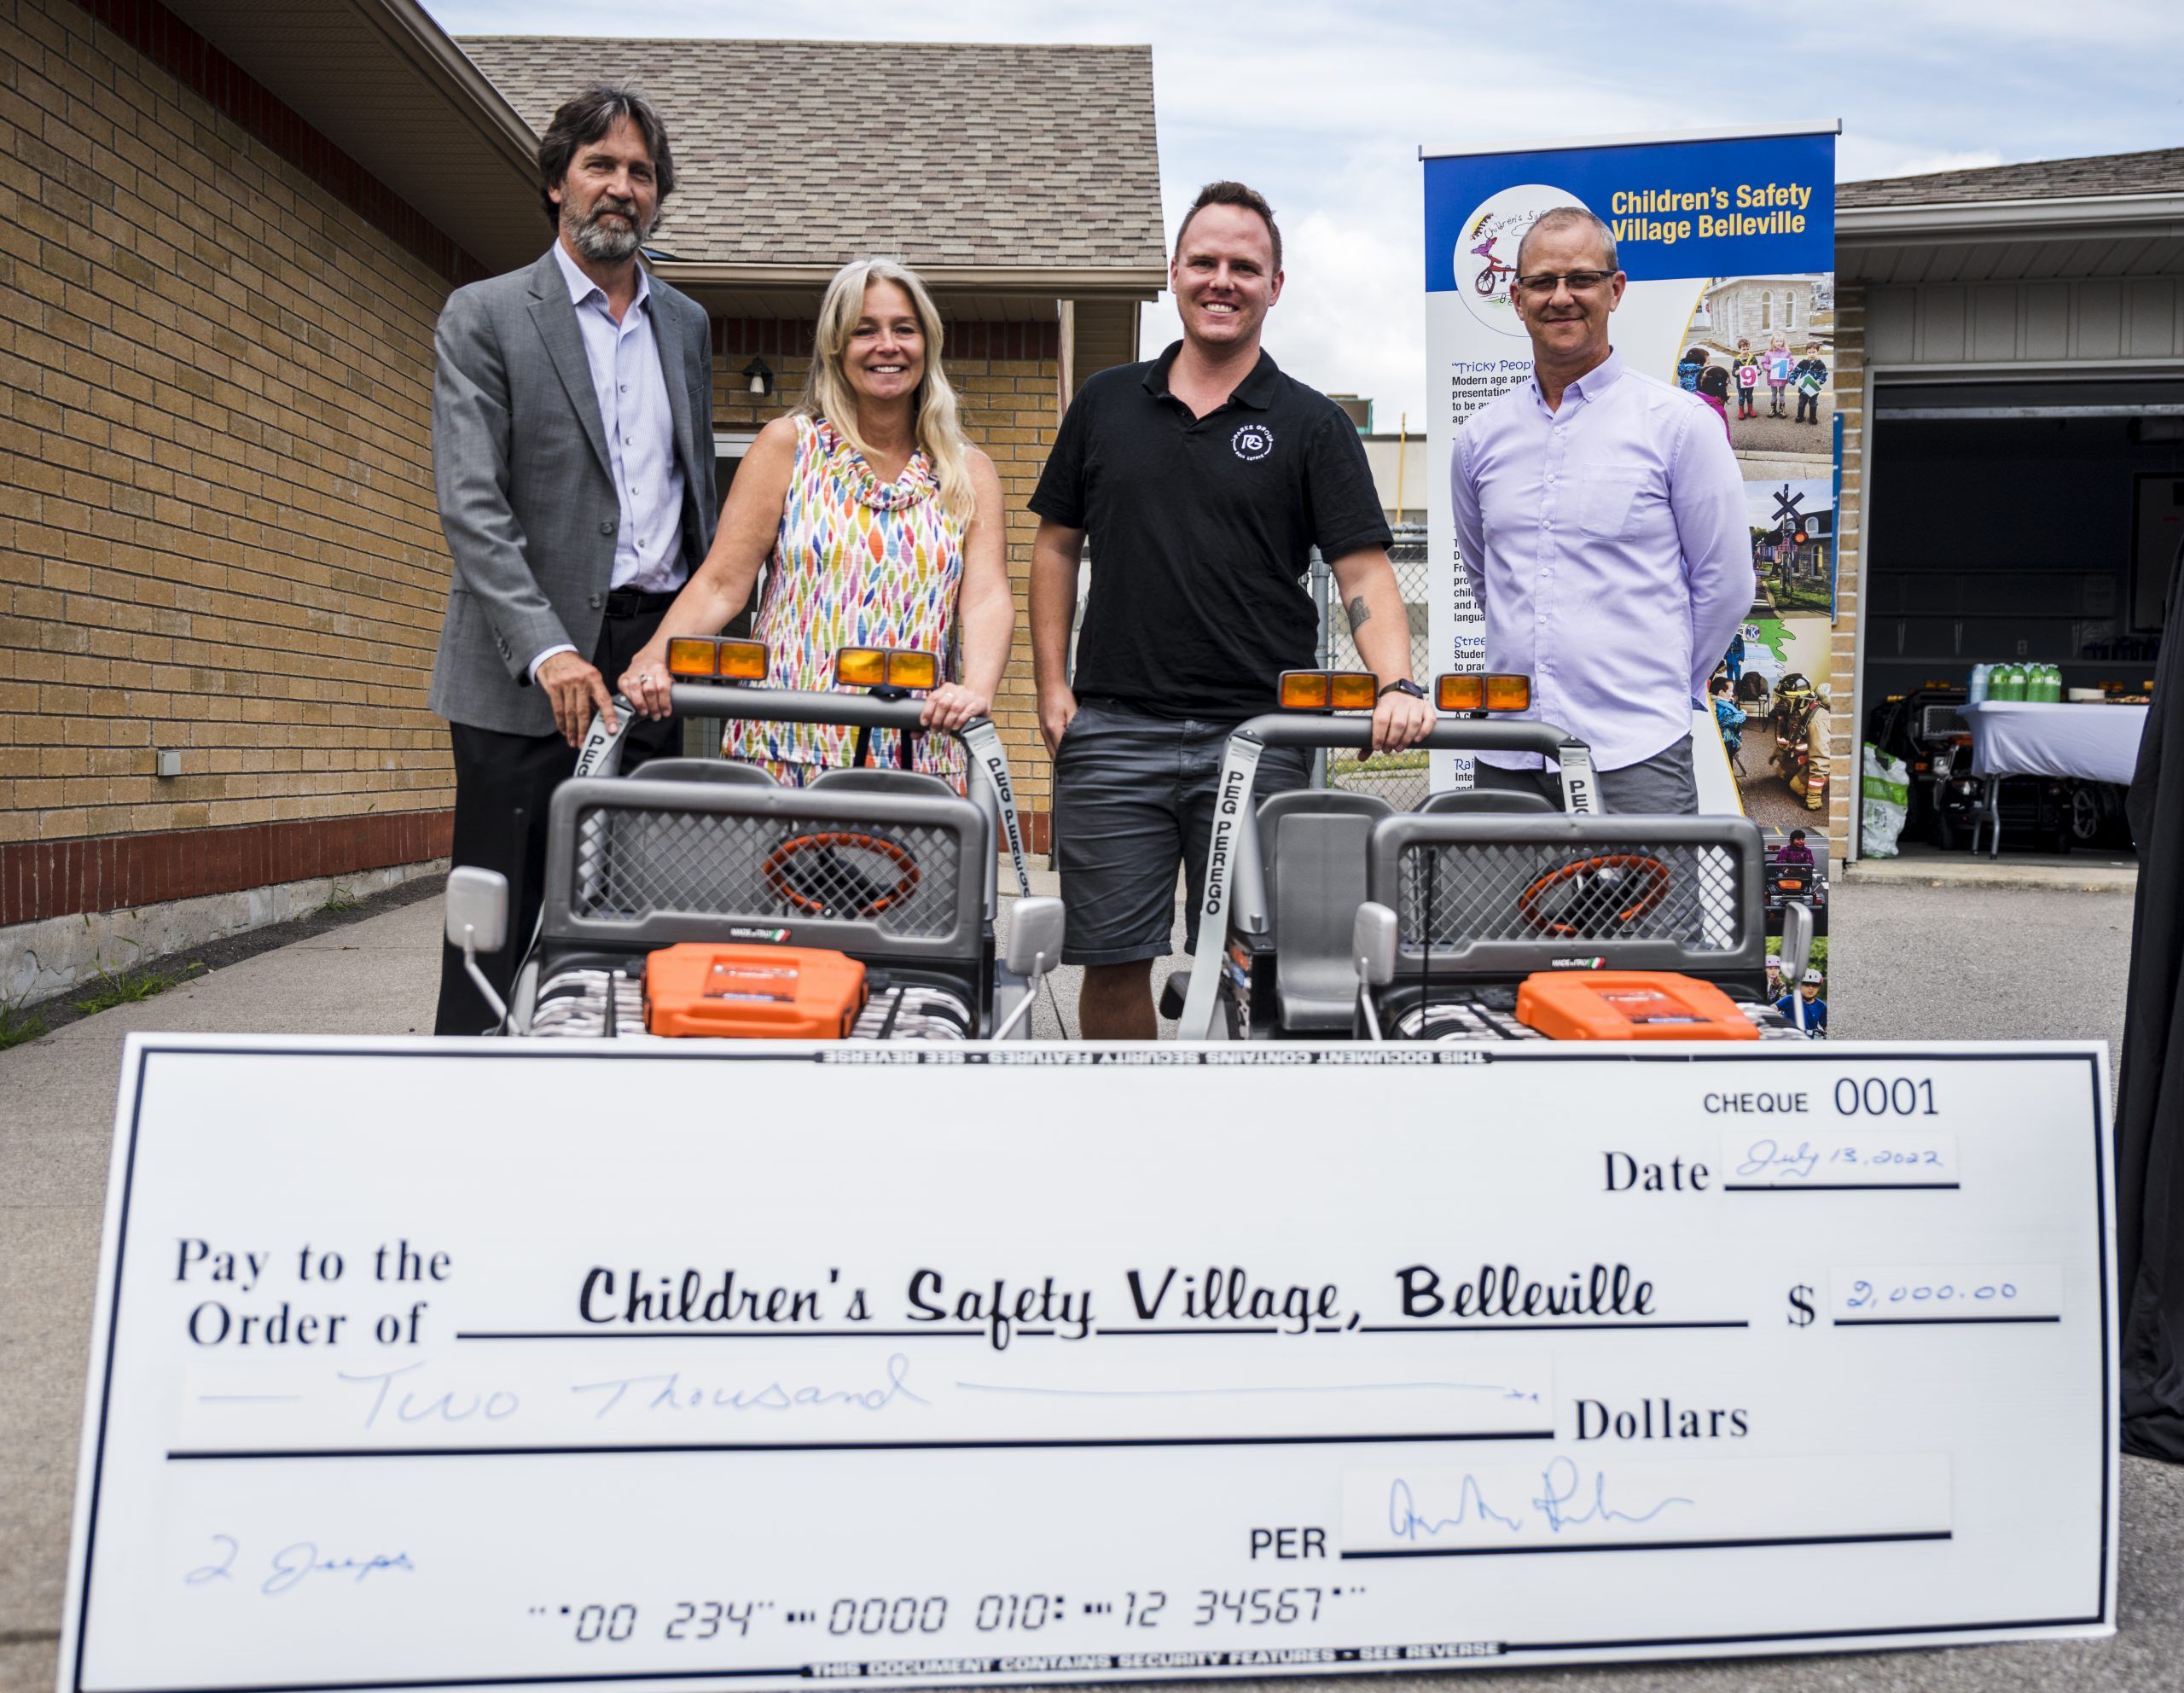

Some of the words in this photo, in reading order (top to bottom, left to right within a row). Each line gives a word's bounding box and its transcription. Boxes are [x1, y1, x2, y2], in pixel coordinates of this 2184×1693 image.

[1736, 183, 1812, 210] Safety
[1611, 218, 1691, 245] Village
[1699, 210, 1806, 238] Belleville
[1452, 375, 1488, 386] Modern
[1490, 375, 1507, 386] age
[1740, 367, 1757, 387] 9
[1771, 359, 1789, 380] 1
[1452, 401, 1461, 410] to
[1464, 401, 1476, 410] be
[1454, 577, 1468, 586] pro
[1454, 600, 1472, 609] and
[1454, 613, 1485, 624] langua
[1454, 636, 1486, 649] Stree
[1455, 662, 1464, 672] to
[987, 757, 1012, 803] PEG
[1454, 759, 1474, 771] Rai
[1221, 771, 1245, 815] PEG
[1205, 821, 1232, 916] PEREGO
[822, 1050, 919, 1064] REVERSE
[924, 1050, 967, 1064] SEE
[1205, 1050, 1313, 1064] CONTAINS
[1316, 1050, 1434, 1064] DOCUMENT
[1439, 1050, 1486, 1064] THIS
[1704, 1092, 1809, 1114] CHEQUE
[1833, 1078, 1939, 1116] 0001
[1600, 1150, 1710, 1191] Date
[1737, 1138, 1819, 1178] July
[1872, 1150, 1943, 1167] 2022
[175, 1238, 270, 1291] Pay
[298, 1243, 345, 1282] to
[374, 1239, 452, 1282] the
[188, 1300, 347, 1346] Order
[375, 1300, 429, 1346] of
[579, 1265, 874, 1324] Children's
[906, 1268, 1096, 1351] Safety
[1126, 1266, 1362, 1335] Village,
[1395, 1263, 1657, 1318] Belleville
[337, 1360, 520, 1431] Two
[572, 1353, 931, 1419] Thousand
[1573, 1398, 1750, 1441] Dollars
[184, 1533, 239, 1585] 2
[1250, 1527, 1327, 1561] PER
[828, 1597, 949, 1635] 0000
[810, 1661, 859, 1678] THIS
[865, 1658, 994, 1677] DOCUMENT
[999, 1654, 1110, 1673] CONTAINS
[1117, 1650, 1221, 1669] SECURITY
[1228, 1647, 1338, 1667] FEATURES
[1359, 1645, 1399, 1661] SEE
[1405, 1642, 1501, 1661] REVERSE
